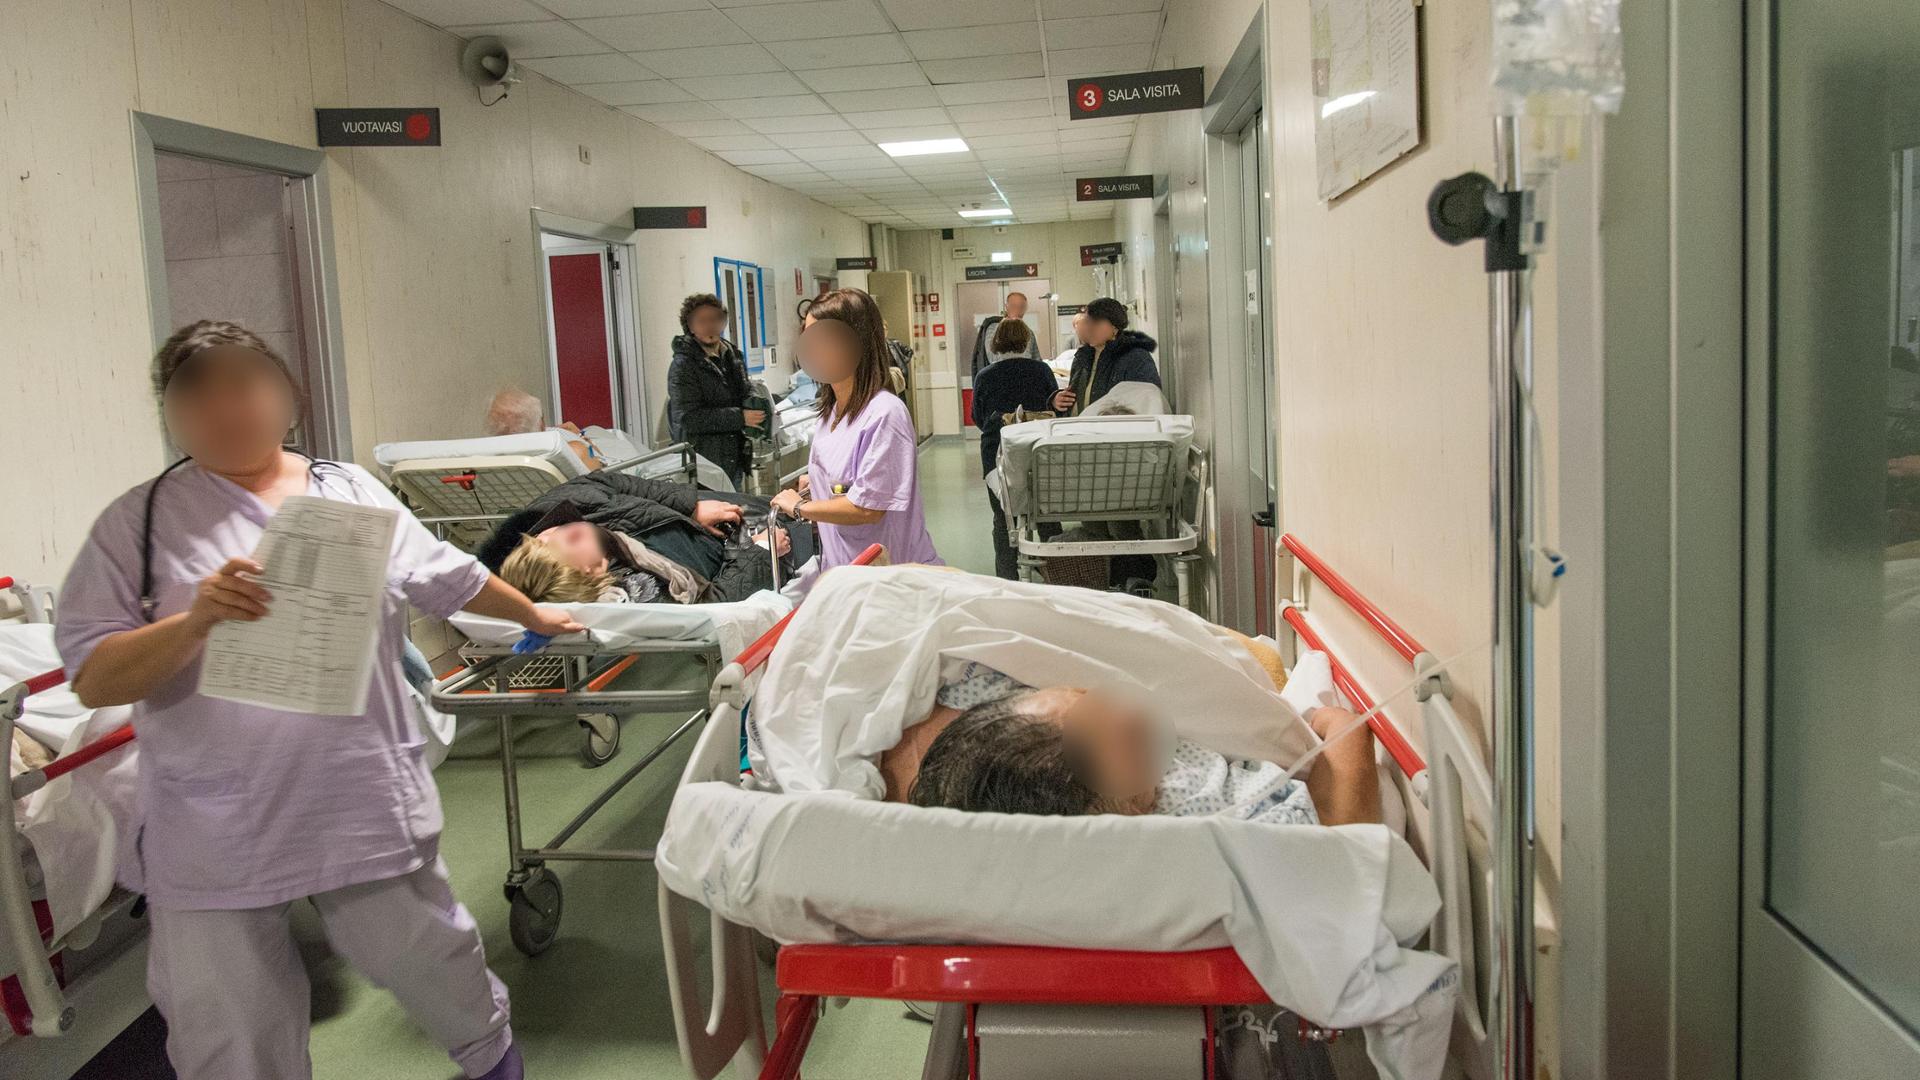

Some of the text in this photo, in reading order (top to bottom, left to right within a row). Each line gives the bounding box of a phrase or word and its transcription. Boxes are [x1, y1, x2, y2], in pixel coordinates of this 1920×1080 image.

[1083, 84, 1181, 107] 3 SALA VISITA
[342, 121, 403, 133] VUOTAVASI
[1084, 183, 1140, 195] 2 SALA VISITA
